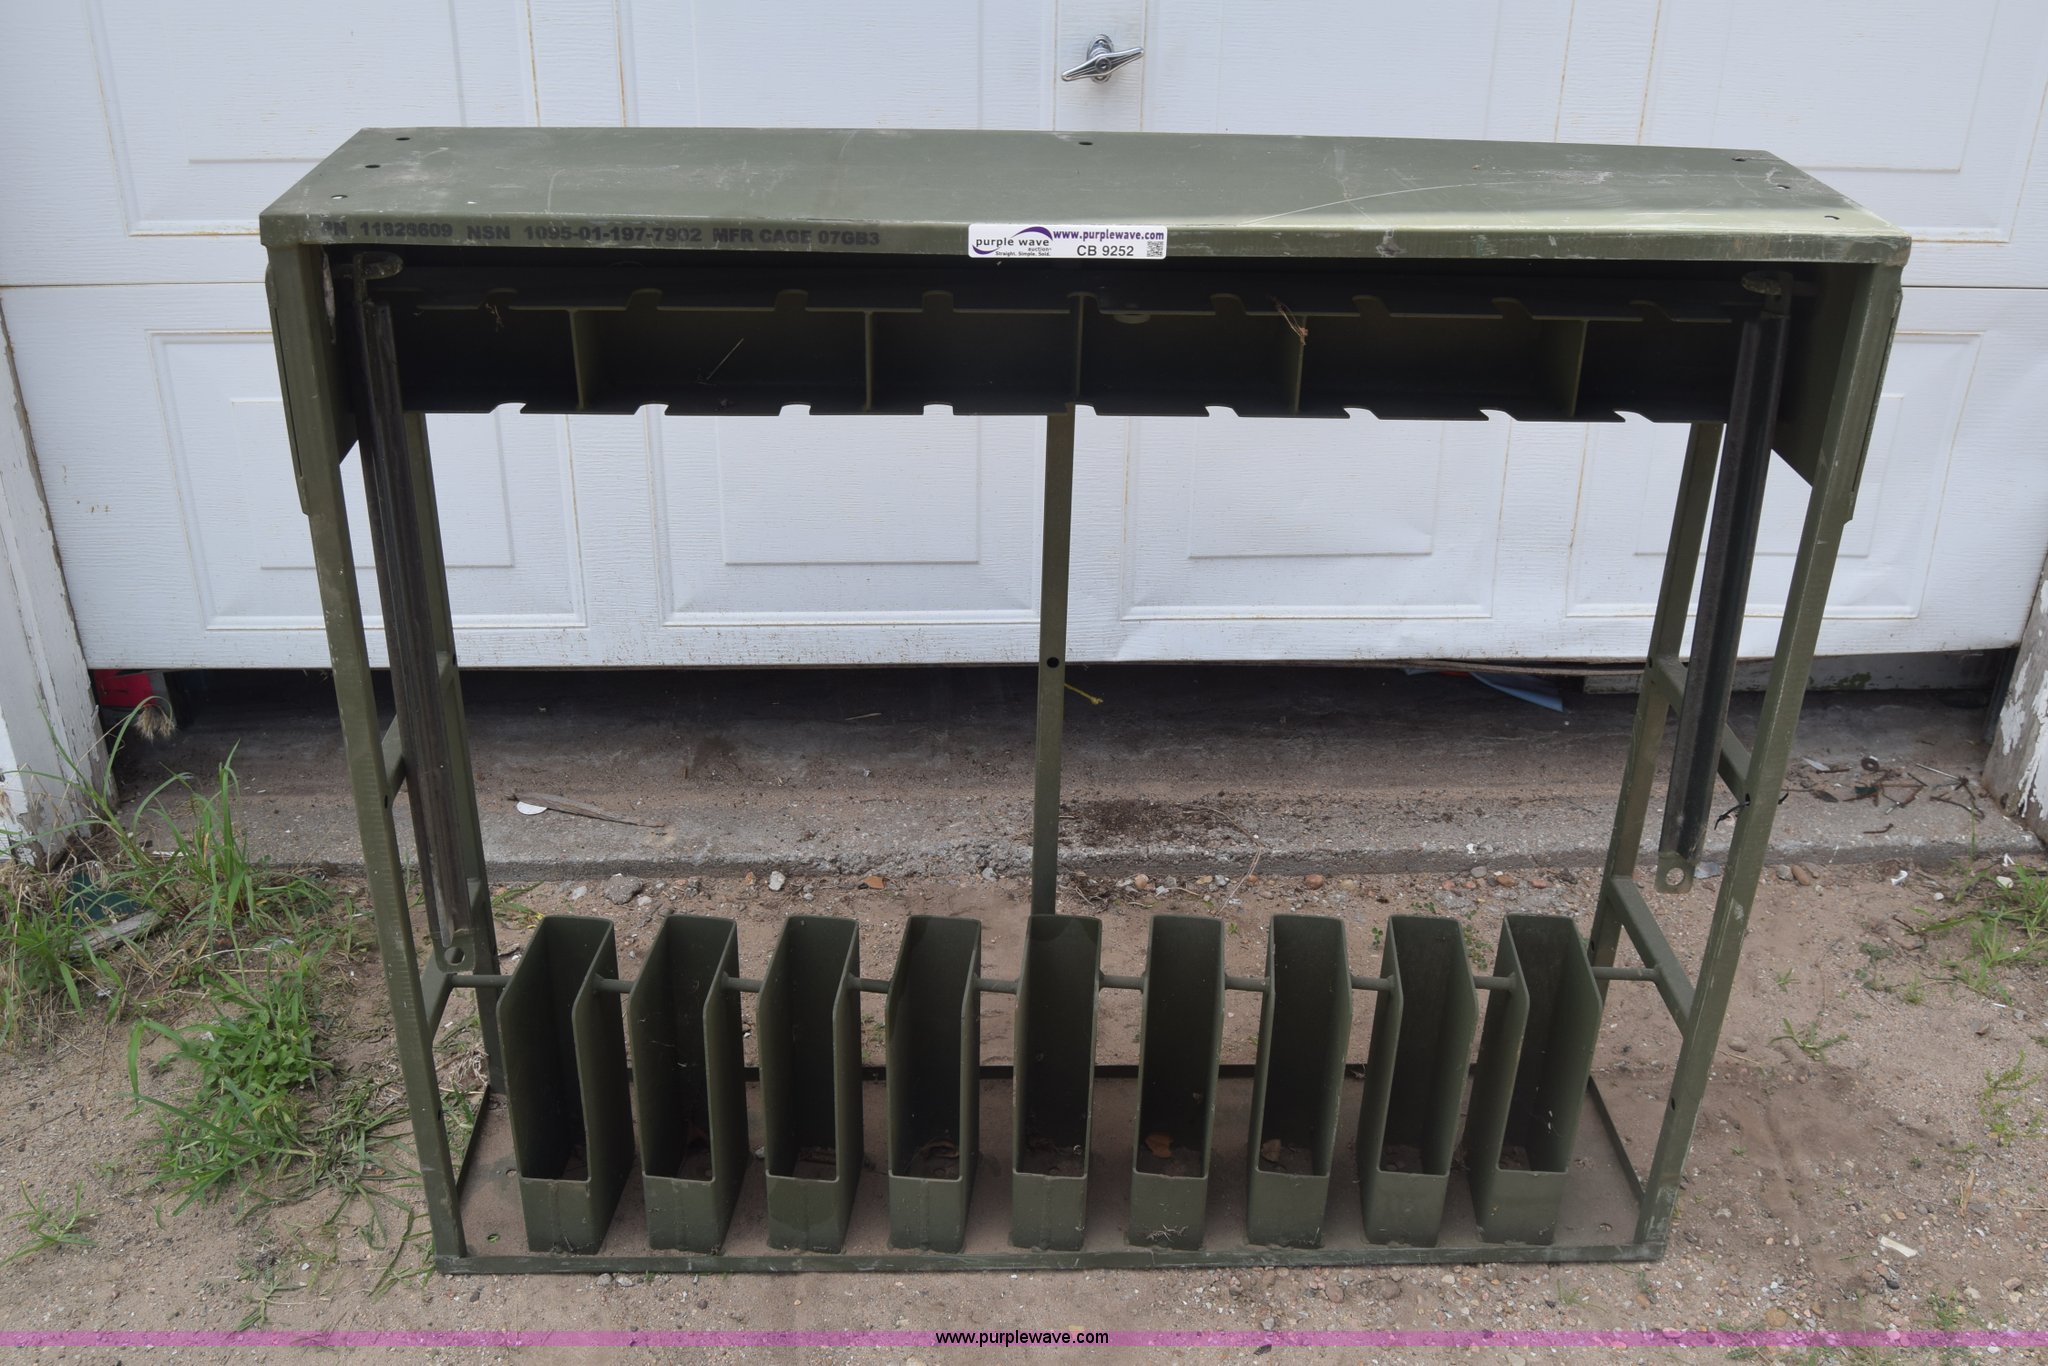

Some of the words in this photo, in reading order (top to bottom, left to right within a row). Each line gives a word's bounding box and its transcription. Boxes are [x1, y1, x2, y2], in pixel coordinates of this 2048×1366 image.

[467, 225, 511, 241] NSN
[524, 226, 702, 243] 1095-01-197-7902
[713, 228, 753, 243] MFR
[760, 229, 812, 244] CAGE
[819, 230, 880, 246] 07GB3
[1053, 229, 1164, 242] www.purplewave.com
[976, 237, 1014, 247] purple
[1018, 238, 1050, 247] wave
[1076, 245, 1097, 257] CB
[1102, 245, 1134, 257] 9252
